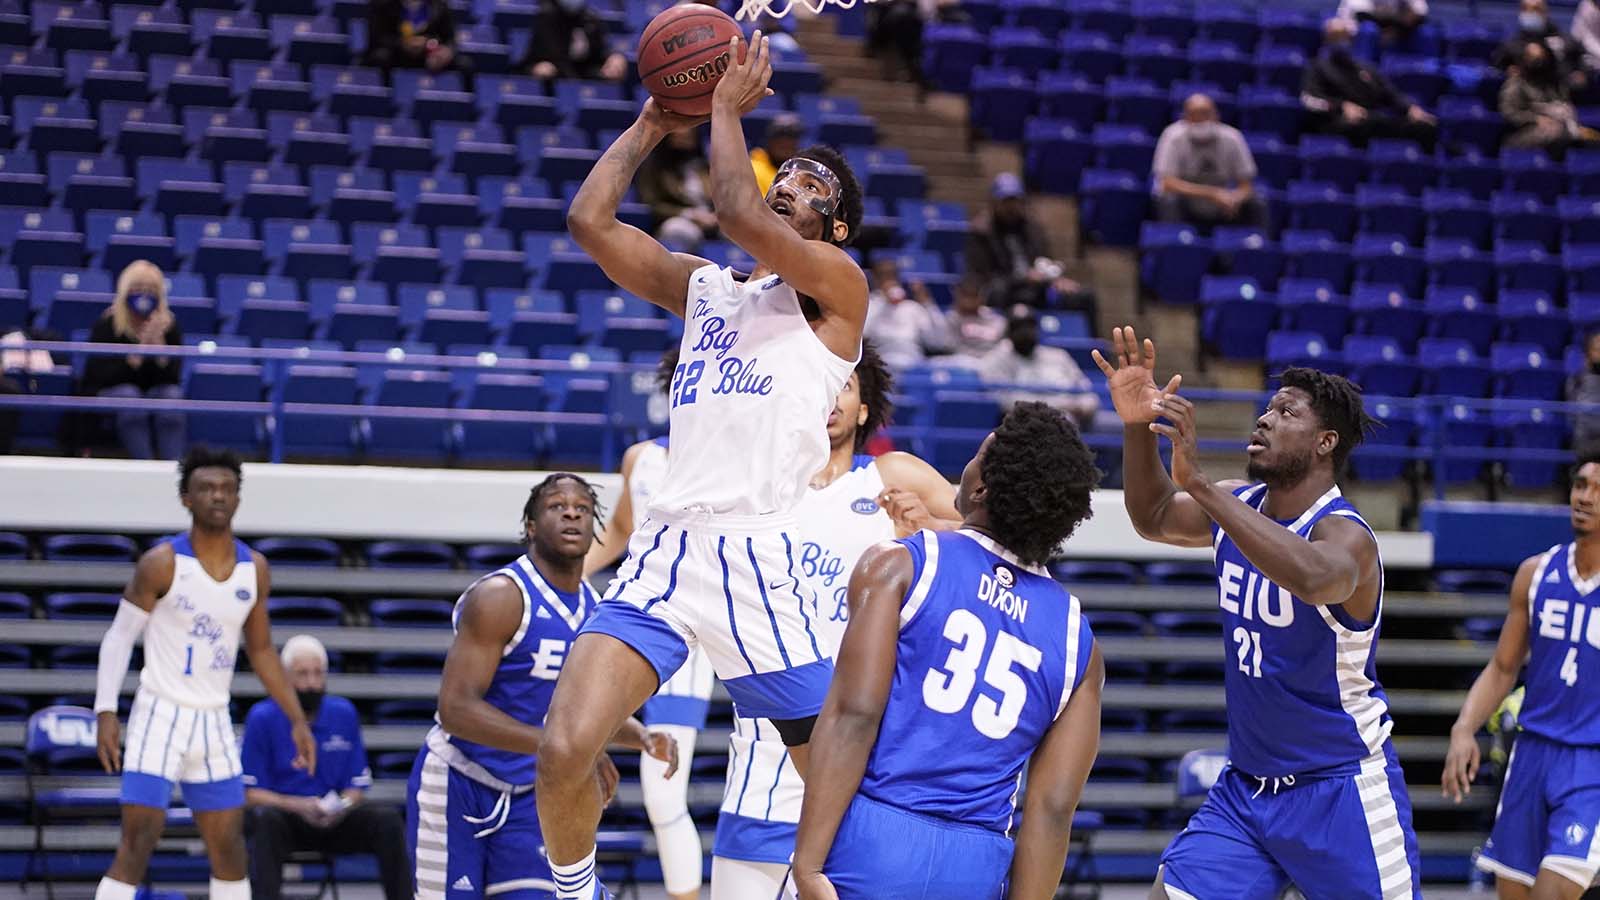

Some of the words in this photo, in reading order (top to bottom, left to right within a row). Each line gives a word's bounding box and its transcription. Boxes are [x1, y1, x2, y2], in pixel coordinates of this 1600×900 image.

[692, 298, 714, 320] The
[692, 316, 739, 360] Big
[672, 360, 705, 410] 22
[712, 357, 773, 396] Blue
[801, 542, 845, 587] Big
[977, 573, 1028, 624] DIXON
[1219, 560, 1295, 628] EIU
[188, 613, 223, 645] Big
[184, 645, 193, 675] 1
[922, 608, 1043, 740] 35
[1233, 626, 1262, 678] 21
[1560, 647, 1578, 687] 4
